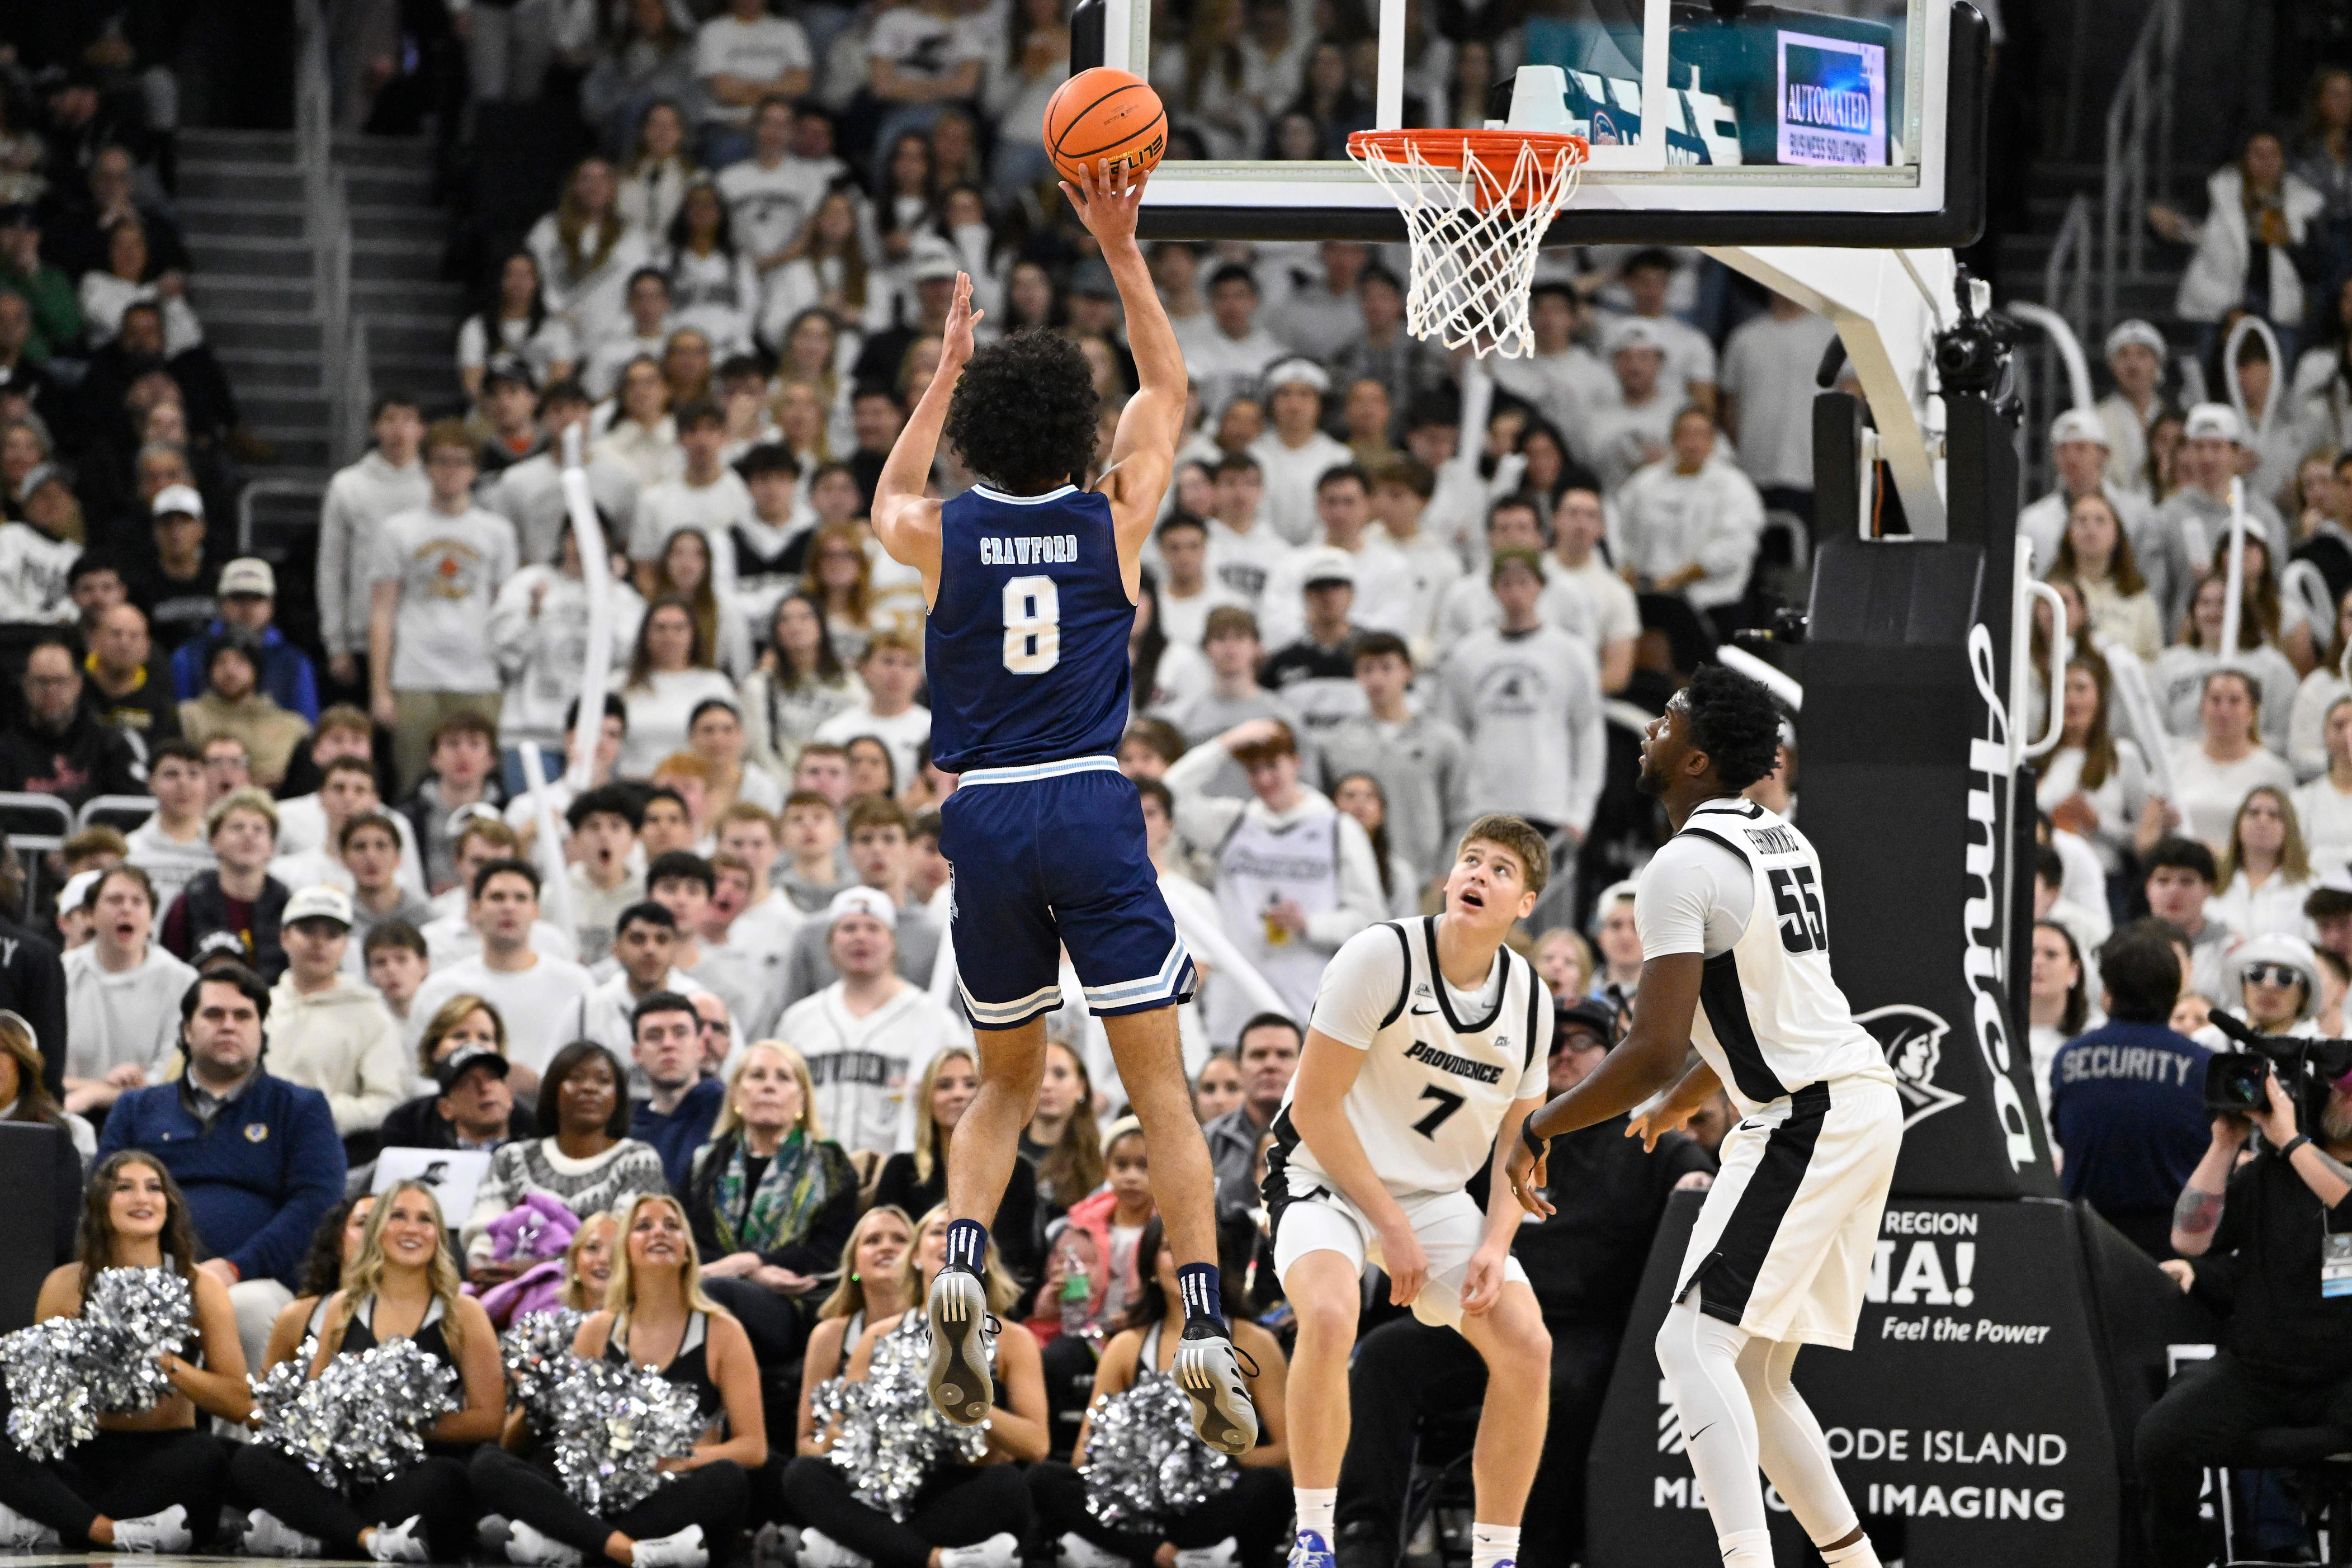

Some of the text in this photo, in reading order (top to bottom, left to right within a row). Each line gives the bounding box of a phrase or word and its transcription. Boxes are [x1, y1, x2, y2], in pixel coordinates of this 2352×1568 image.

[1787, 83, 1869, 129] AUTOMATED
[1109, 134, 1163, 174] ELITE
[1789, 133, 1866, 165] BUSINESS SOLUTIONS
[980, 535, 1077, 565] CRAWFORD
[1002, 574, 1060, 675] 8
[1764, 863, 1828, 956] 55
[1963, 622, 2036, 1174] Amica
[1402, 1038, 1505, 1085] PROVIDENCE
[2062, 1045, 2193, 1087] SECURITY
[1410, 1083, 1467, 1142] 7
[1885, 1211, 1978, 1236] REGION
[1882, 1316, 2051, 1344] Feel the Power
[1824, 1427, 2067, 1466] ODE ISLAND
[1868, 1483, 2065, 1522] IMAGING
